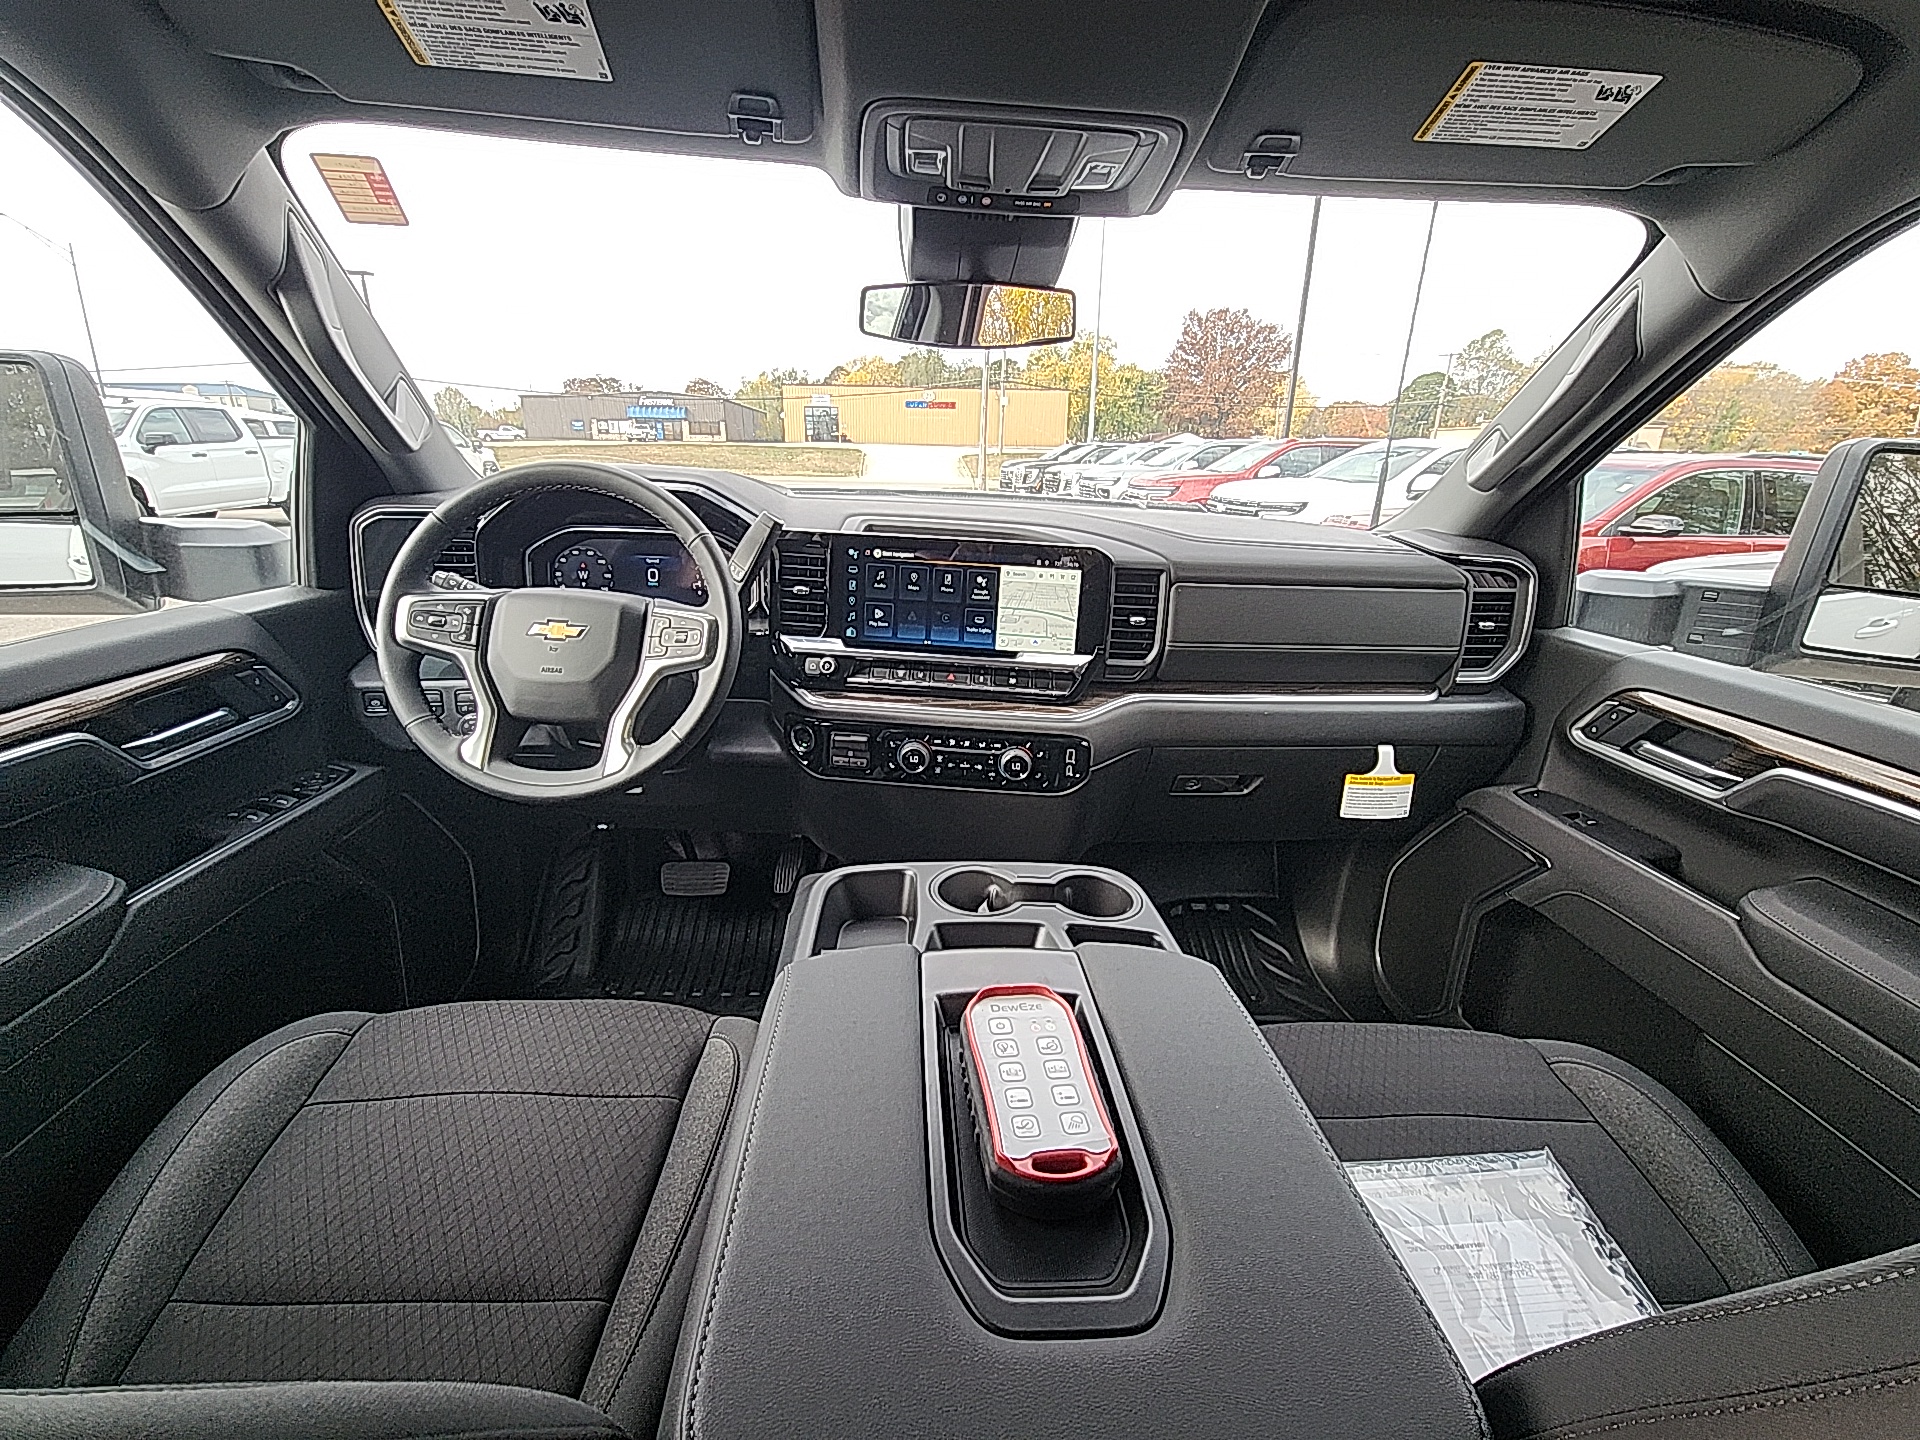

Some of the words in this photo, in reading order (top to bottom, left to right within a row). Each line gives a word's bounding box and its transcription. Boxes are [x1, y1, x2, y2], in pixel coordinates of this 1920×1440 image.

[430, 23, 448, 31] AVEC
[464, 26, 482, 34] SACS
[527, 32, 573, 41] INTELLIGENTS
[577, 570, 589, 580] W
[647, 568, 659, 582] 0
[541, 666, 563, 674] AIRBAG
